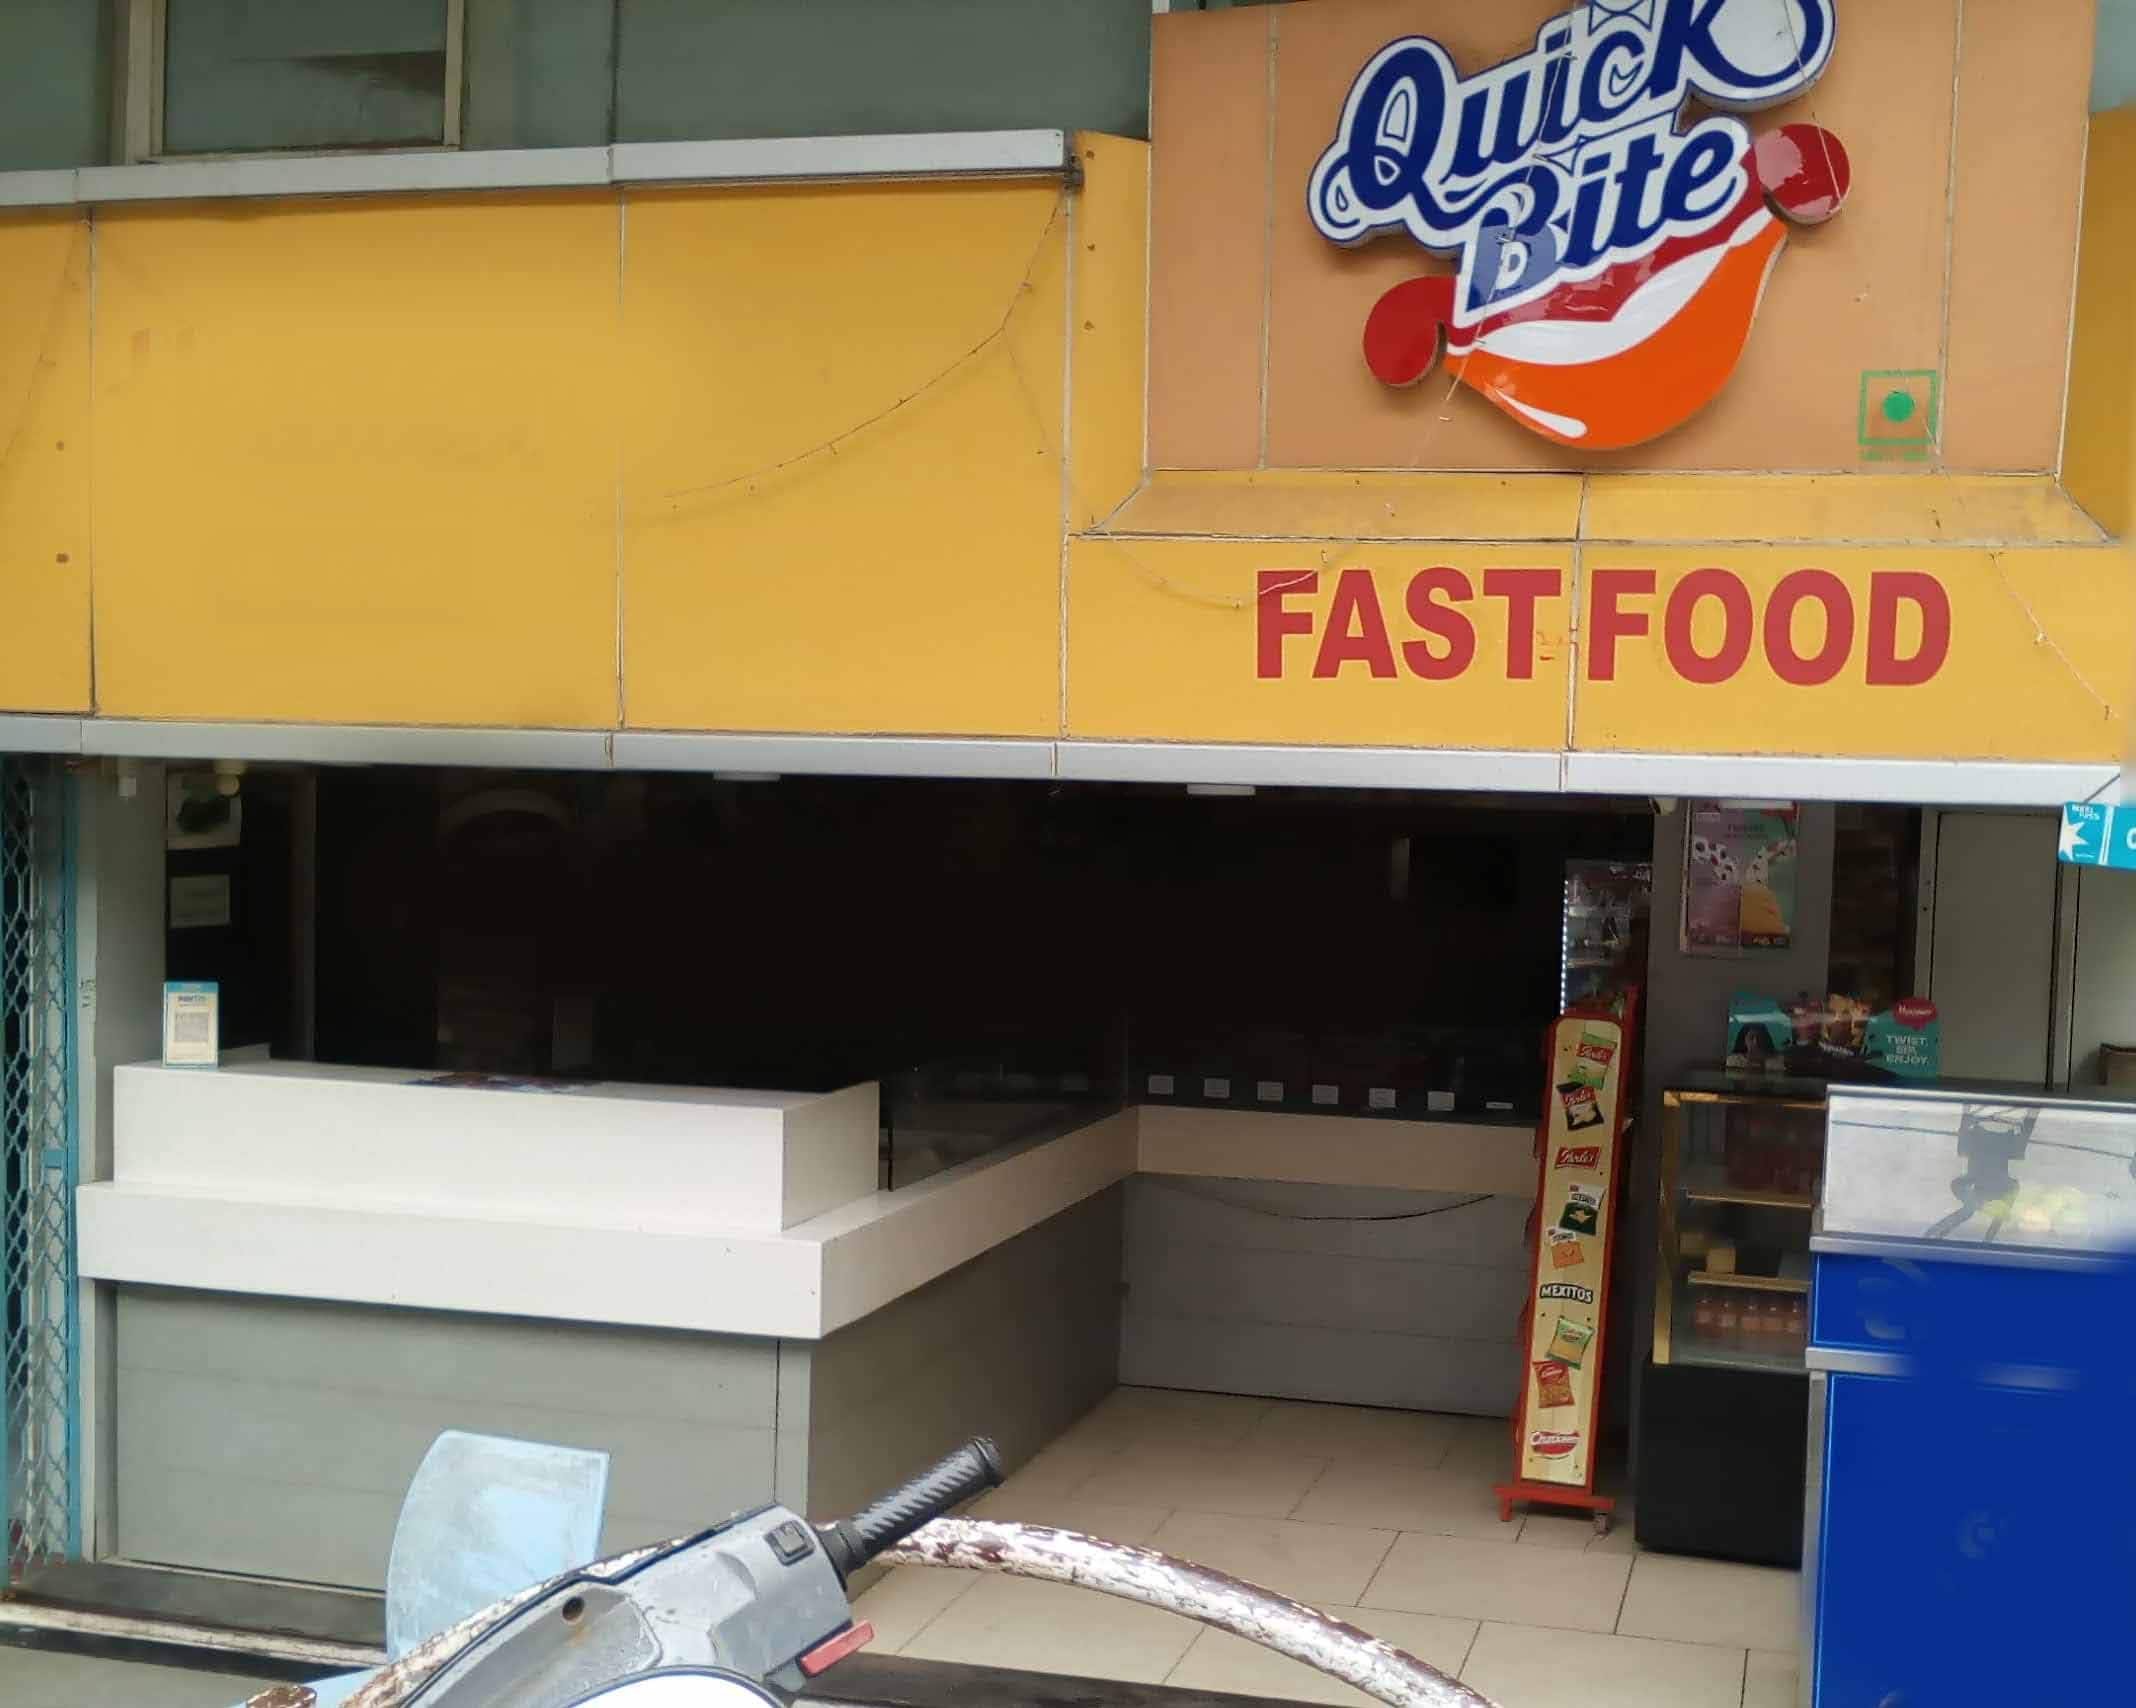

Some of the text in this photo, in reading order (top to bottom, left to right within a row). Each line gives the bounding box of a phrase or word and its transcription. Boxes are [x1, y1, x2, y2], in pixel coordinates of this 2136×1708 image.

[1316, 0, 1830, 234] Quick
[1463, 118, 1745, 312] Bite
[1257, 567, 1951, 686] FAST FOOD
[1540, 1284, 1592, 1304] MEXITOS
